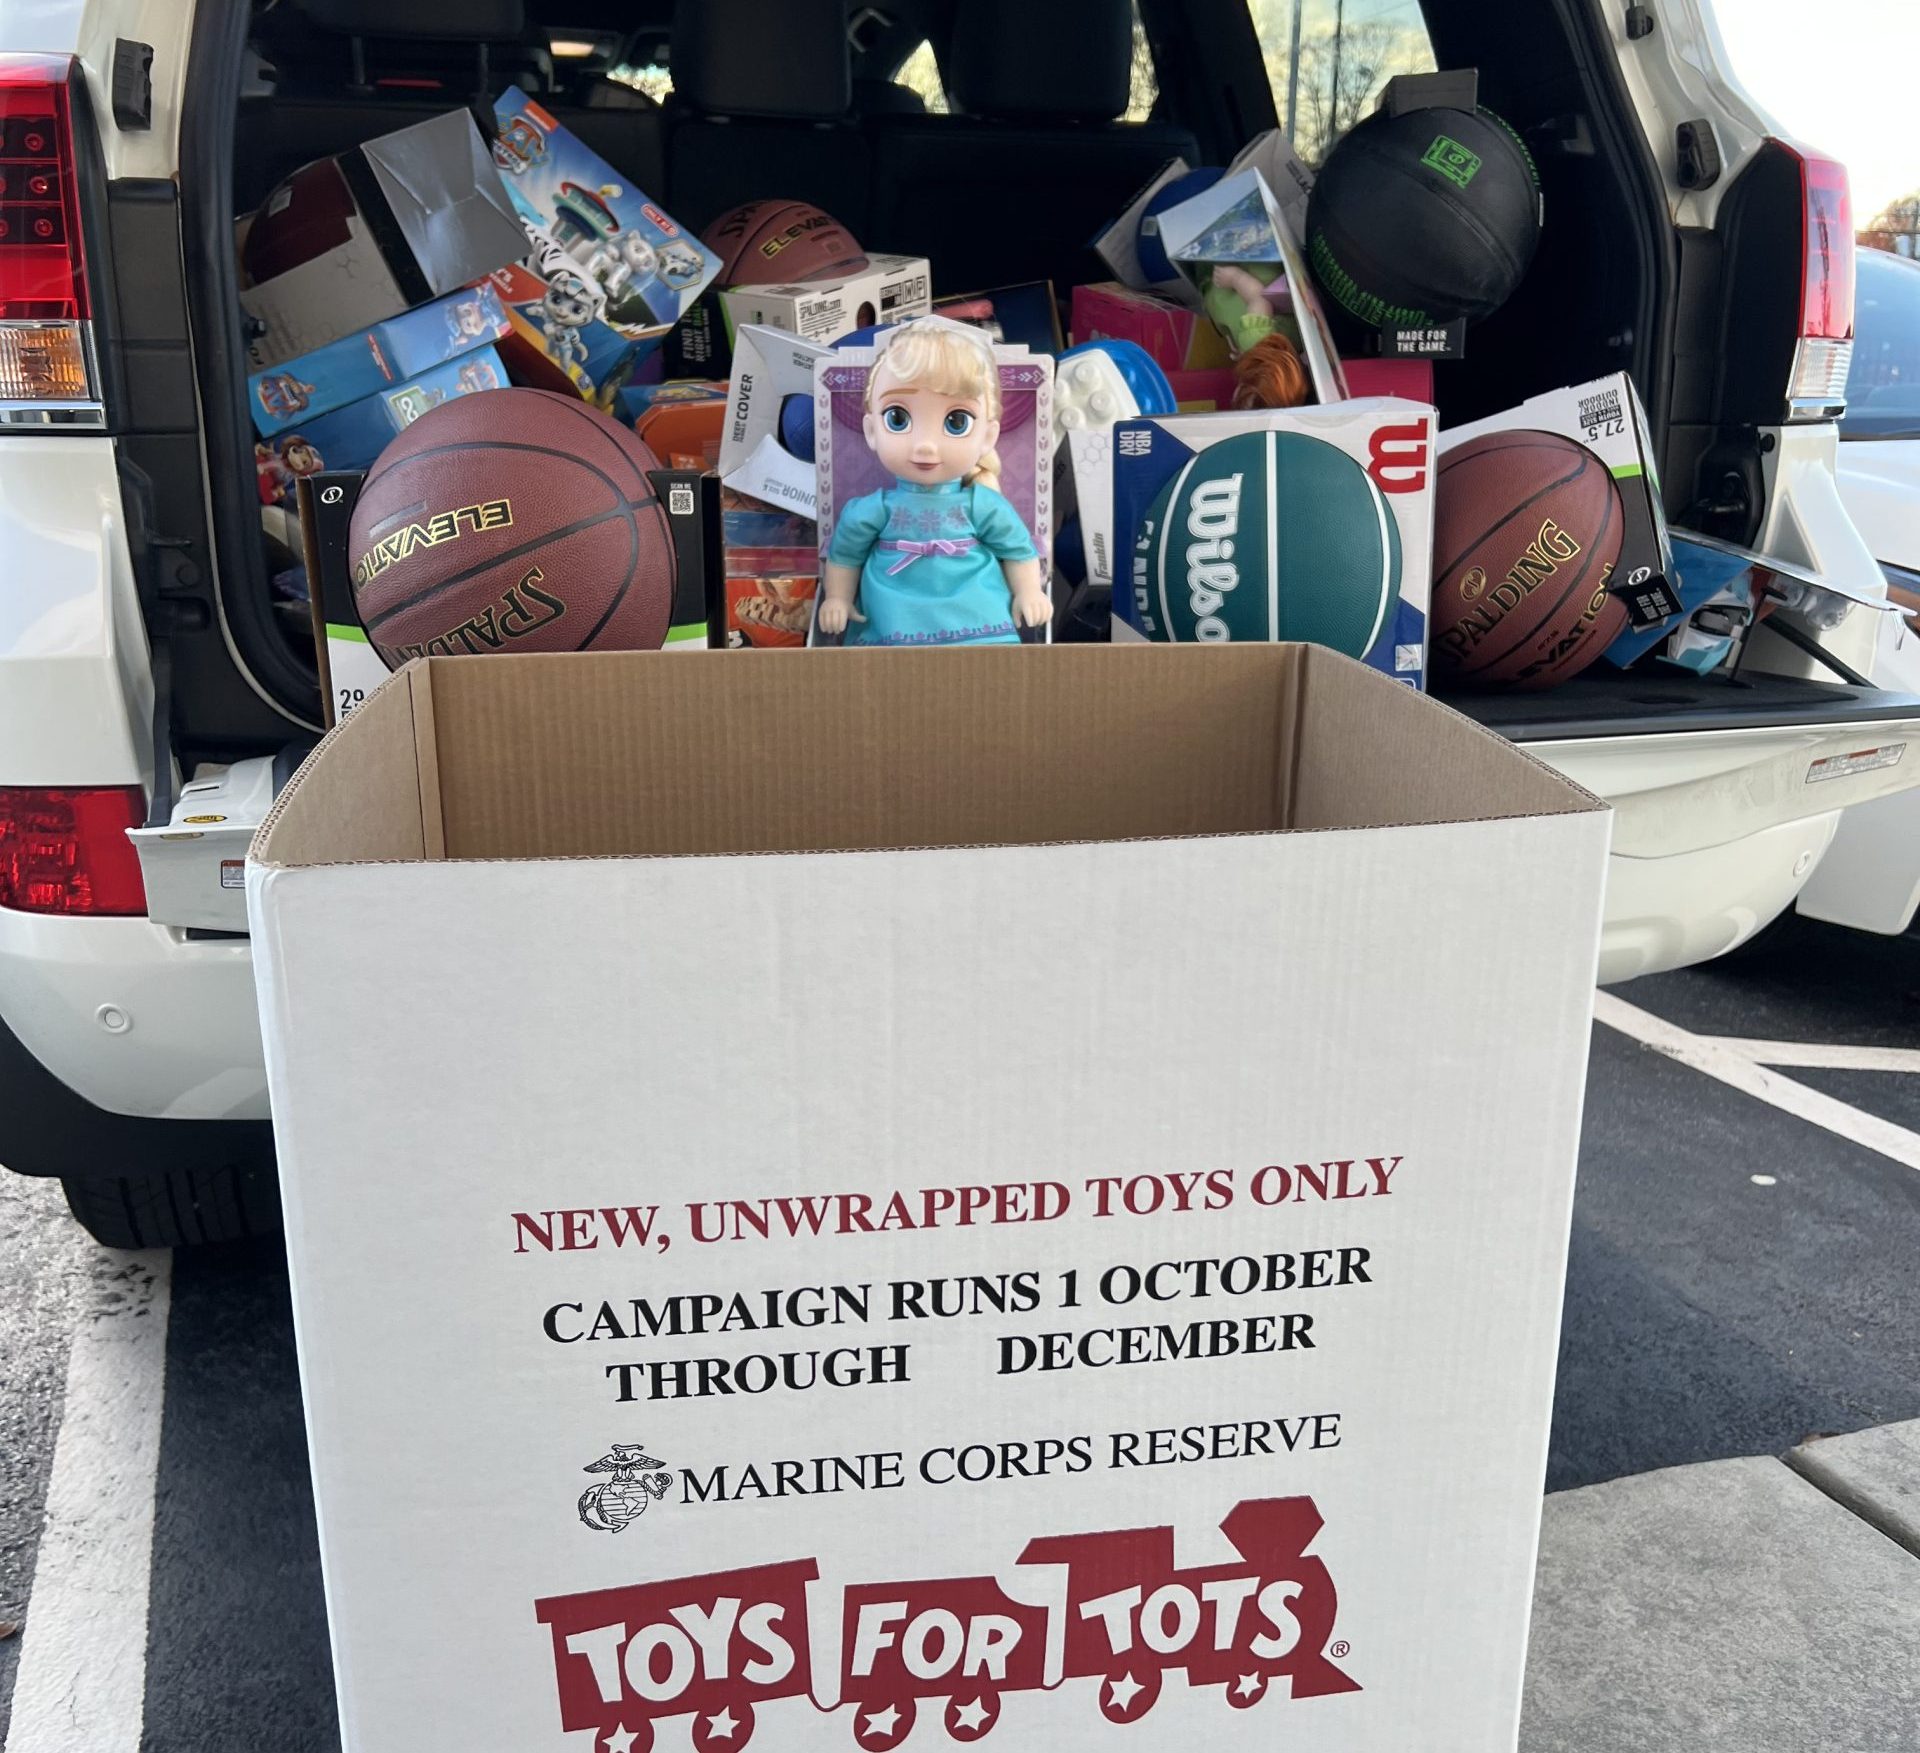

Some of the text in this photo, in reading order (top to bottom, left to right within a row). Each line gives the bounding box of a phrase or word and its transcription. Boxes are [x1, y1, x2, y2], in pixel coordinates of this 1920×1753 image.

[1396, 329, 1447, 341] MADE FOR
[1397, 341, 1415, 353] THE
[736, 374, 753, 420] COVER
[1119, 431, 1135, 456] DRV
[1136, 431, 1151, 456] NBA
[782, 485, 817, 507] UNIOR
[355, 499, 514, 588] ELEVATIO
[1186, 473, 1244, 643] Wilso
[512, 1156, 1403, 1256] NEW, UNWRAPPED TOYS ONLY
[543, 1247, 1373, 1344] CAMPAIGN RUNS 1 OCTOBER
[606, 1313, 1317, 1403] THROUGH DECEMBER
[677, 1413, 1342, 1504] MARINE CORPS RESERVE
[565, 1597, 796, 1703] TOYS
[851, 1601, 1023, 1681] FOR
[1079, 1576, 1304, 1660] TOTS
